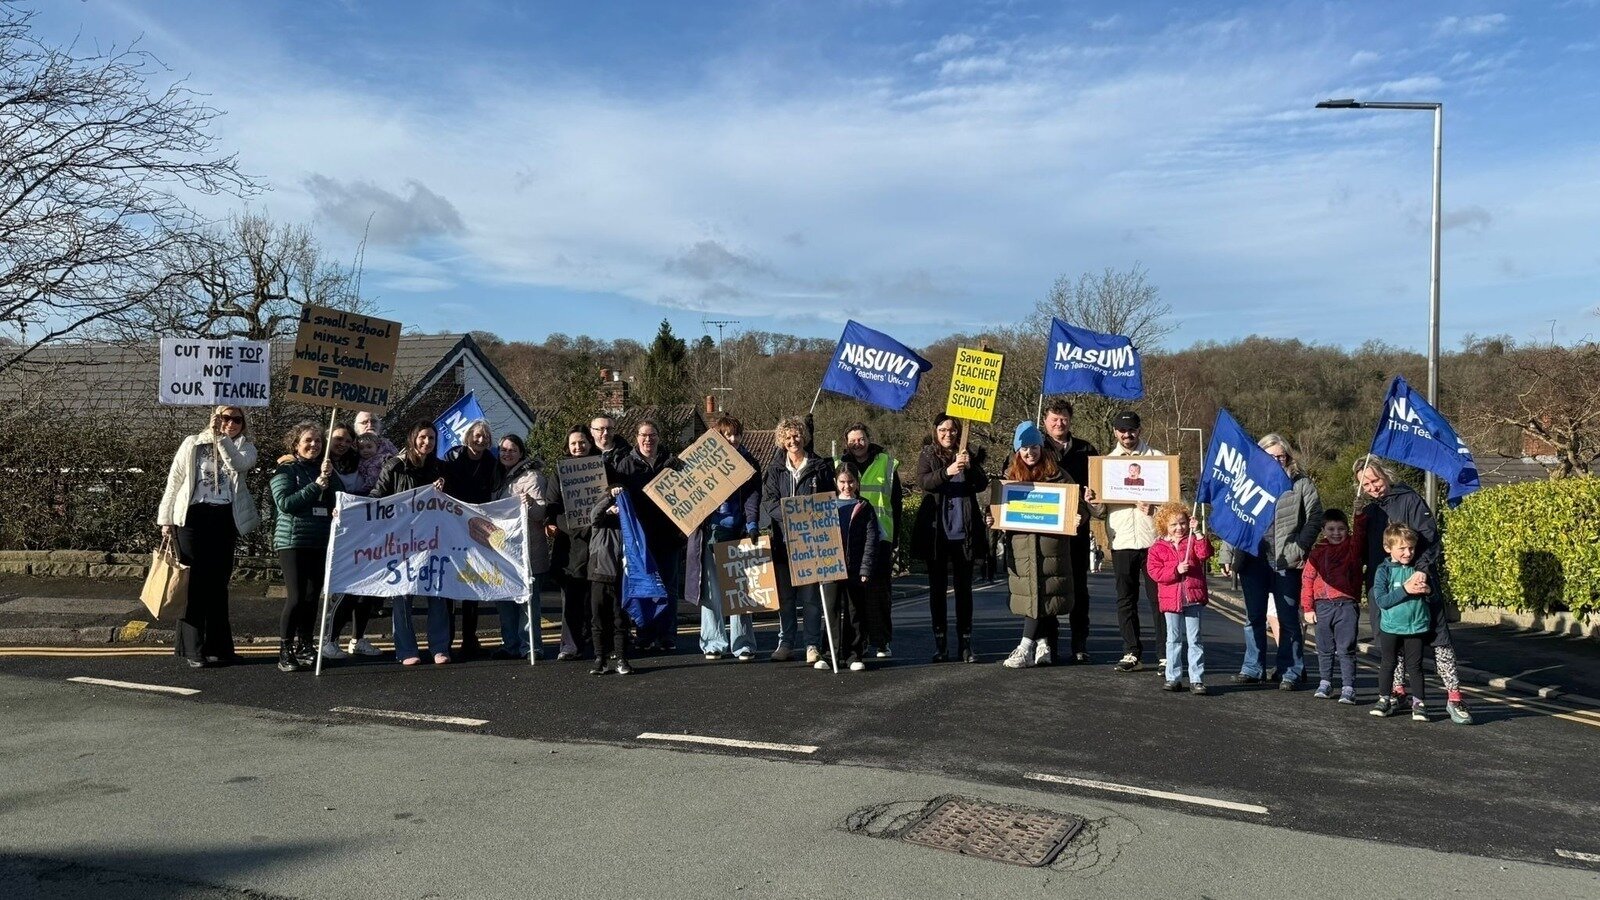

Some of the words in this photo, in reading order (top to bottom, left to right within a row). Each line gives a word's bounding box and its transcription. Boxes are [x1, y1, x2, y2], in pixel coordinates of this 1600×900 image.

[301, 307, 312, 323] 1
[314, 313, 348, 329] small
[348, 318, 391, 339] school
[313, 329, 350, 346] minus
[355, 336, 366, 350] 1
[174, 344, 200, 359] CUT
[207, 346, 234, 360] THE
[295, 344, 329, 363] whole
[331, 347, 389, 373] teacher
[840, 342, 920, 380] NASUWT
[960, 350, 982, 365] Save
[984, 357, 1000, 368] our
[1055, 341, 1135, 370] NASUWT
[203, 364, 233, 378] NOT
[837, 361, 853, 372] The
[854, 367, 887, 382] Teachers'
[887, 374, 910, 388] Union
[956, 363, 998, 382] TEACHER.
[1054, 361, 1070, 371] The
[170, 382, 204, 396] OUR
[212, 381, 268, 400] TEACHER
[288, 374, 300, 393] 1
[301, 376, 329, 397] BIG
[331, 381, 388, 406] PROBLEM
[954, 379, 976, 394] Save
[978, 387, 994, 397] our
[951, 393, 990, 411] SCHOOL.
[439, 423, 452, 440] The
[1388, 419, 1409, 432] The
[560, 460, 604, 475] CHILDREN
[664, 489, 680, 506] BY
[678, 472, 700, 492] THE
[696, 445, 729, 475] TRUST
[1212, 467, 1230, 484] The
[563, 473, 604, 487] SHOULDN'T
[566, 489, 581, 499] PAY
[585, 485, 602, 496] THE
[671, 500, 693, 521] PAID
[689, 486, 708, 505] FOR
[703, 472, 719, 491] BY
[717, 458, 736, 476] US
[366, 500, 395, 521] The
[411, 489, 464, 516] loaves
[574, 495, 598, 508] PRICE
[784, 499, 802, 514] St
[568, 509, 583, 519] FOR
[788, 518, 809, 531] has
[812, 513, 840, 529] heart
[1231, 500, 1256, 526] Union
[354, 526, 439, 564] multiplied
[799, 531, 830, 544] Trust
[817, 545, 839, 557] tear
[386, 554, 450, 592] Staff
[722, 556, 771, 577] TRUST
[798, 567, 813, 578] us
[816, 559, 845, 577] apart
[735, 575, 761, 590] THE
[725, 587, 775, 610] TRUST
